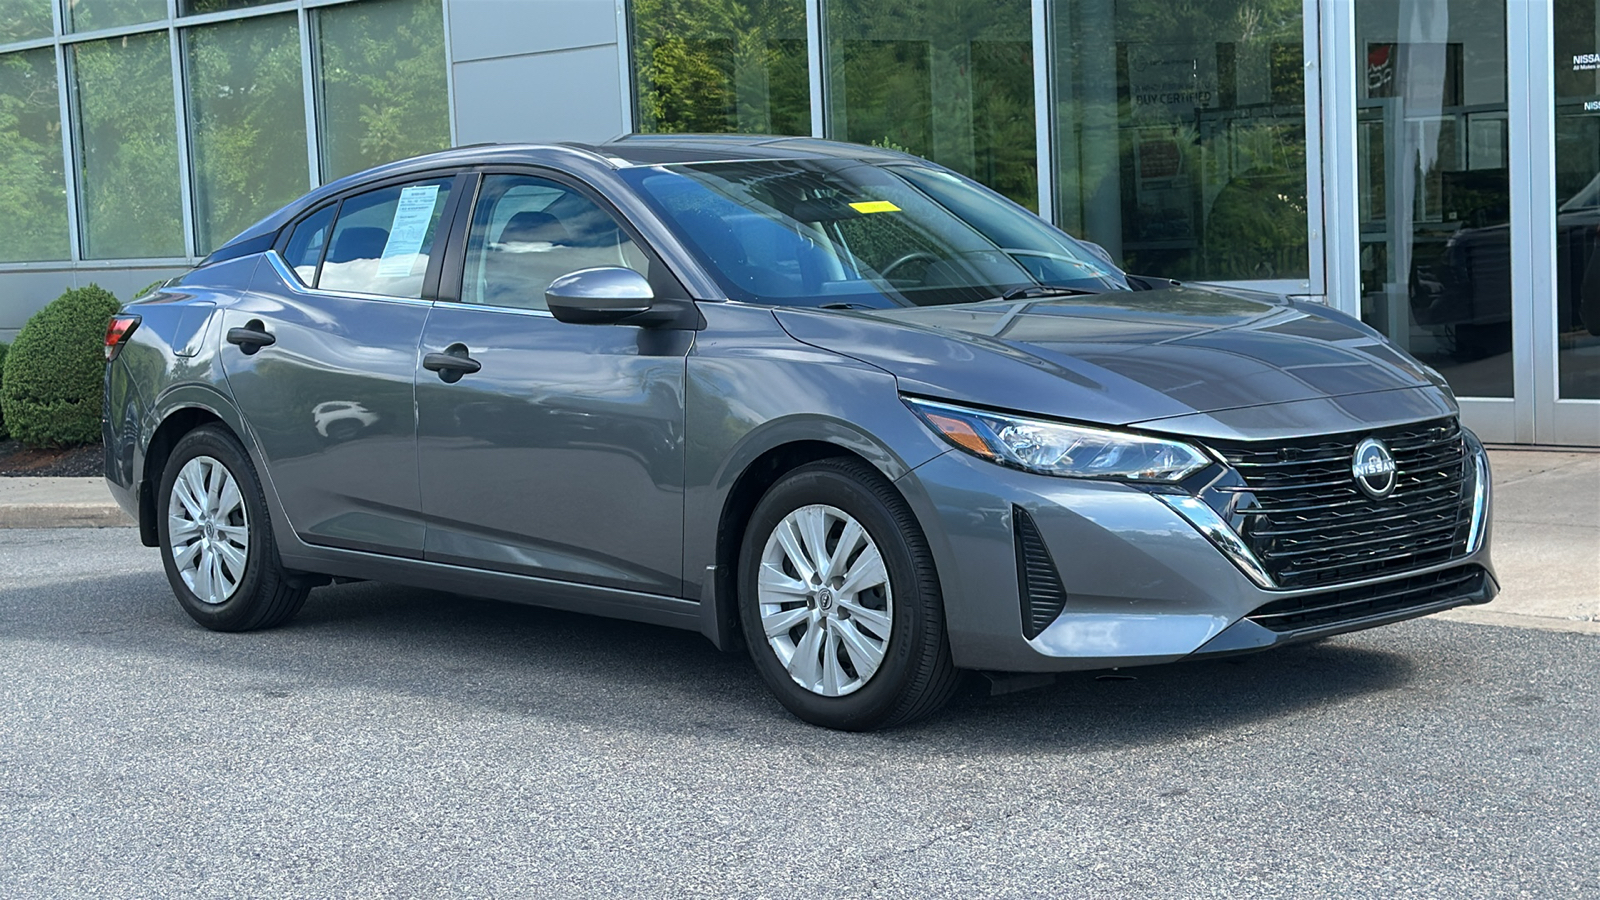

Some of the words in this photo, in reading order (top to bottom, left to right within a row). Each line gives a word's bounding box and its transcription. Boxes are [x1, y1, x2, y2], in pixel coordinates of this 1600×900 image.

[1136, 94, 1158, 105] BUY
[1160, 91, 1212, 104] CERTIFIED
[1354, 461, 1395, 475] NISSAN
